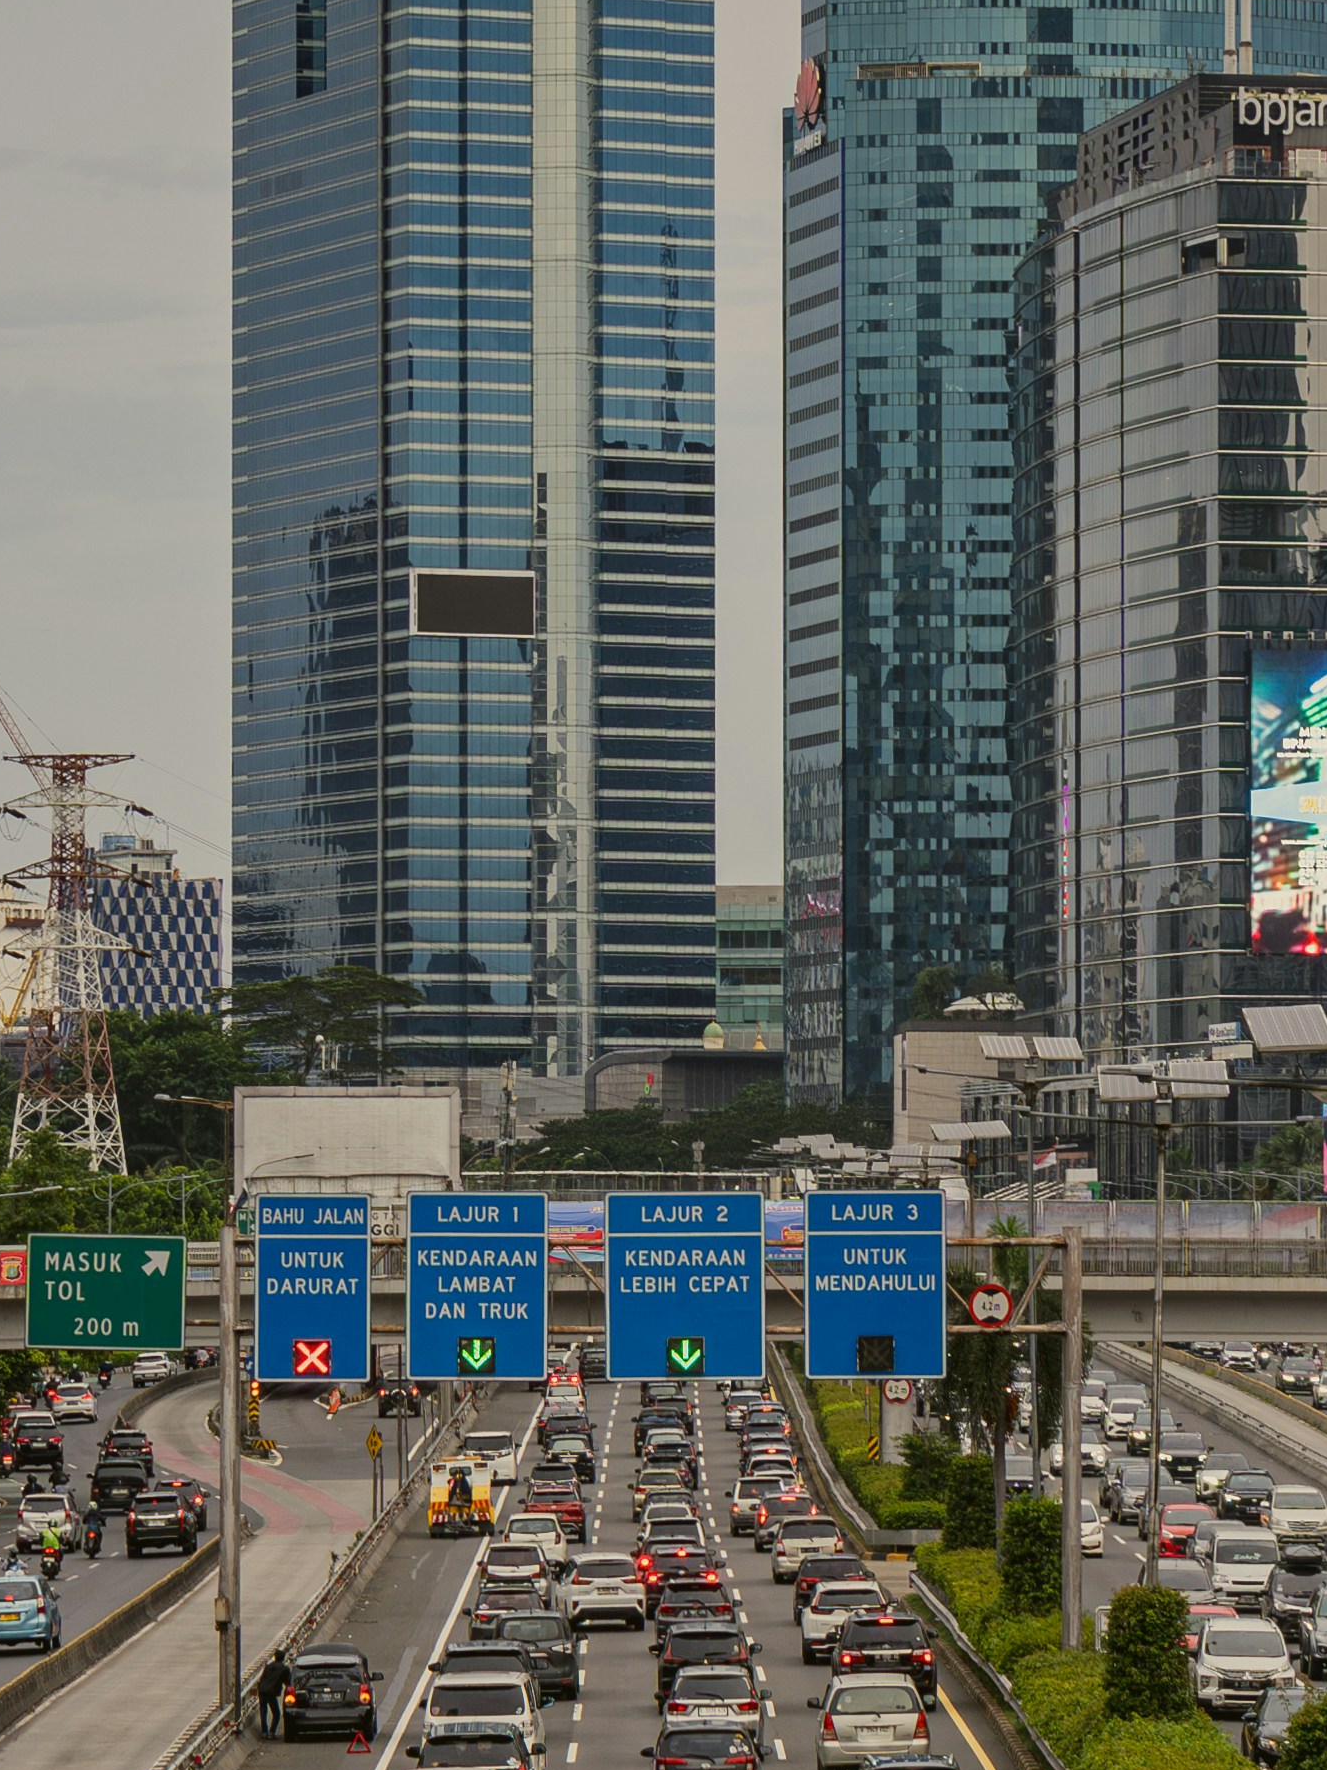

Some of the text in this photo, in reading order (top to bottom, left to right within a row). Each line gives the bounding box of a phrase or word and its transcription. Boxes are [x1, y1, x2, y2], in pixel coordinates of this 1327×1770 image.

[262, 1207, 365, 1225] BAHU JALAN
[437, 1205, 519, 1223] LAJUR 1
[641, 1205, 729, 1223] LAJUR 2
[831, 1203, 920, 1222] LAJUR 3
[45, 1251, 122, 1273] MASUK
[281, 1251, 344, 1269] UNTUK
[417, 1249, 537, 1267] KENDARAAN
[624, 1249, 746, 1267] KENDARAAN
[843, 1247, 907, 1266] UNTUK
[44, 1280, 85, 1302] TOL
[266, 1277, 359, 1295] DARURAT
[438, 1276, 517, 1294] LAMBAT
[620, 1275, 751, 1293] LEBIH CEPAT
[815, 1274, 936, 1292] MENDAHULUI
[425, 1302, 529, 1320] DAN TRUK
[73, 1316, 140, 1337] 200 m
